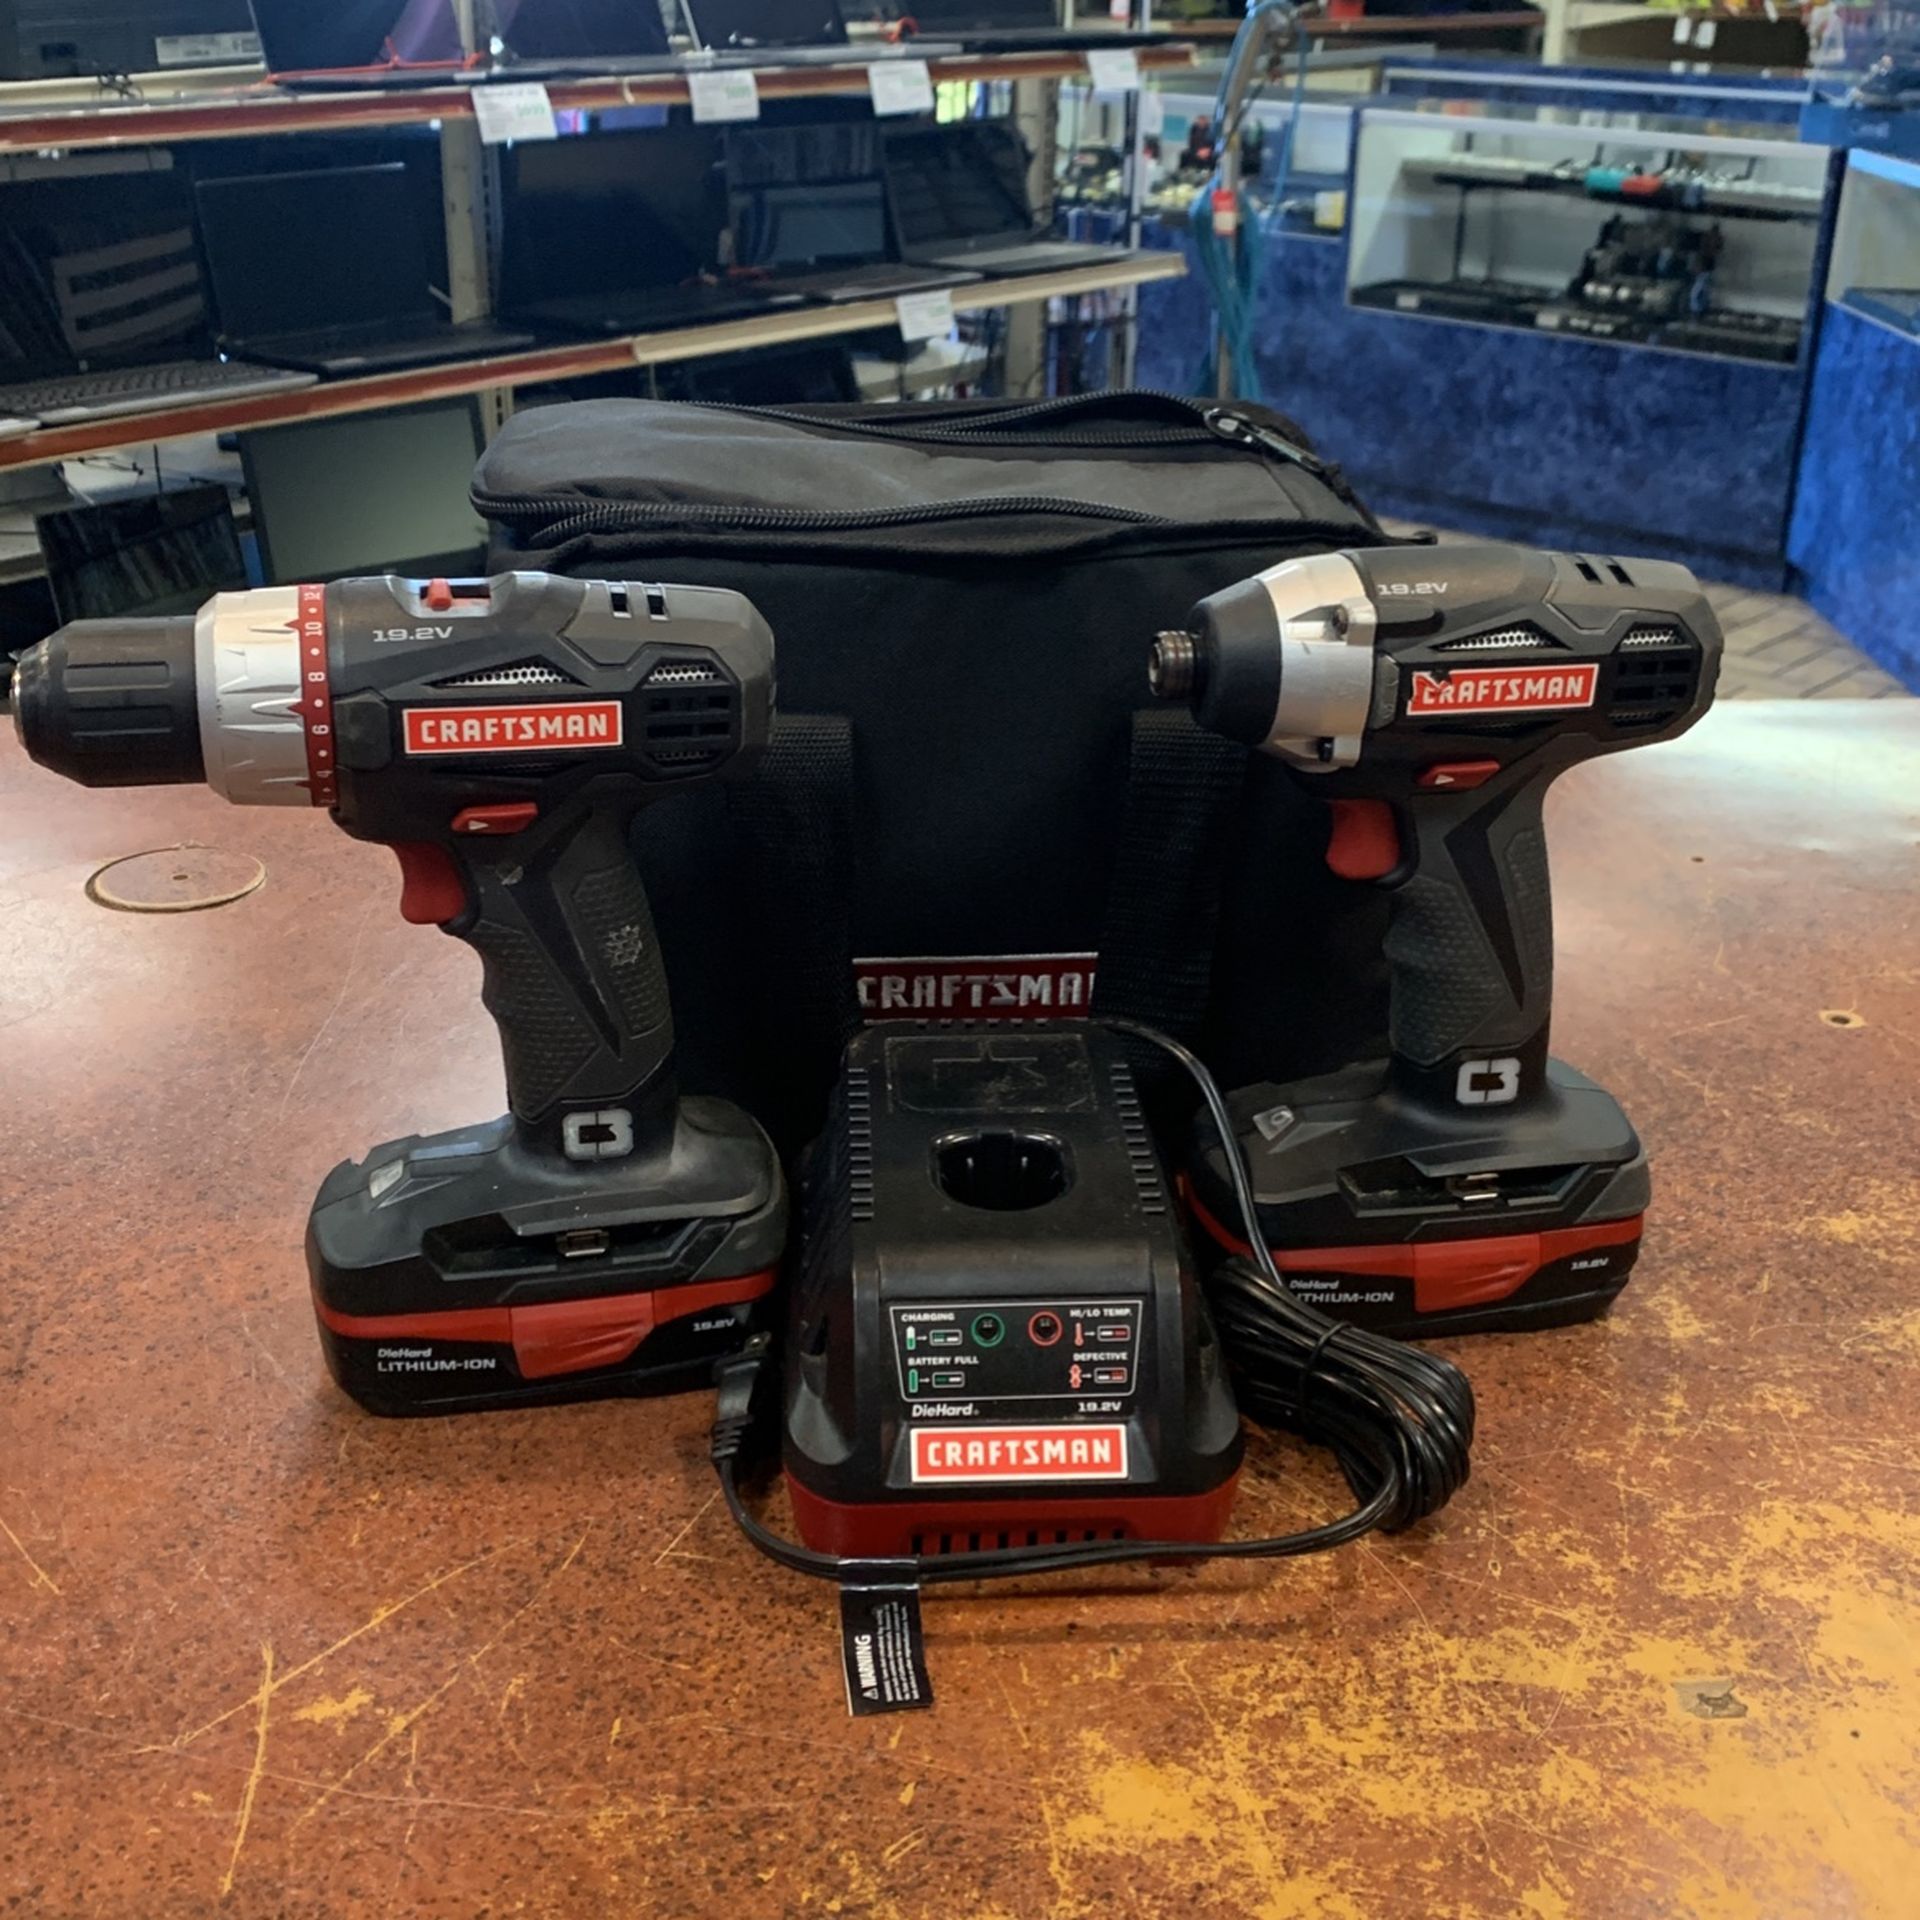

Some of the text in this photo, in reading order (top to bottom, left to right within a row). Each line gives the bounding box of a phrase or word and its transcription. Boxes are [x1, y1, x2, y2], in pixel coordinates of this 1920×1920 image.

[1377, 582, 1448, 596] 19.2V
[304, 621, 323, 636] 10
[372, 626, 453, 642] 19.2V
[307, 671, 326, 682] 8
[311, 724, 330, 735] 6
[421, 713, 608, 744] CRAFTSMAN
[857, 972, 1096, 1009] CRAFTSMA
[1289, 1280, 1340, 1289] DieHard
[1296, 1292, 1395, 1302] ITHIUM-ION
[901, 1312, 955, 1322] CHARGING
[1069, 1308, 1101, 1318] HI/LO
[377, 1348, 433, 1358] DieHard
[1073, 1352, 1129, 1361] DEFECTIVE
[377, 1359, 496, 1372] LITHIUM-ION
[908, 1355, 979, 1366] BATTERY FULL
[1078, 1401, 1122, 1412] 19.2V
[927, 1438, 1111, 1468] CRAFTSMAN
[854, 1634, 878, 1689] WARNING
